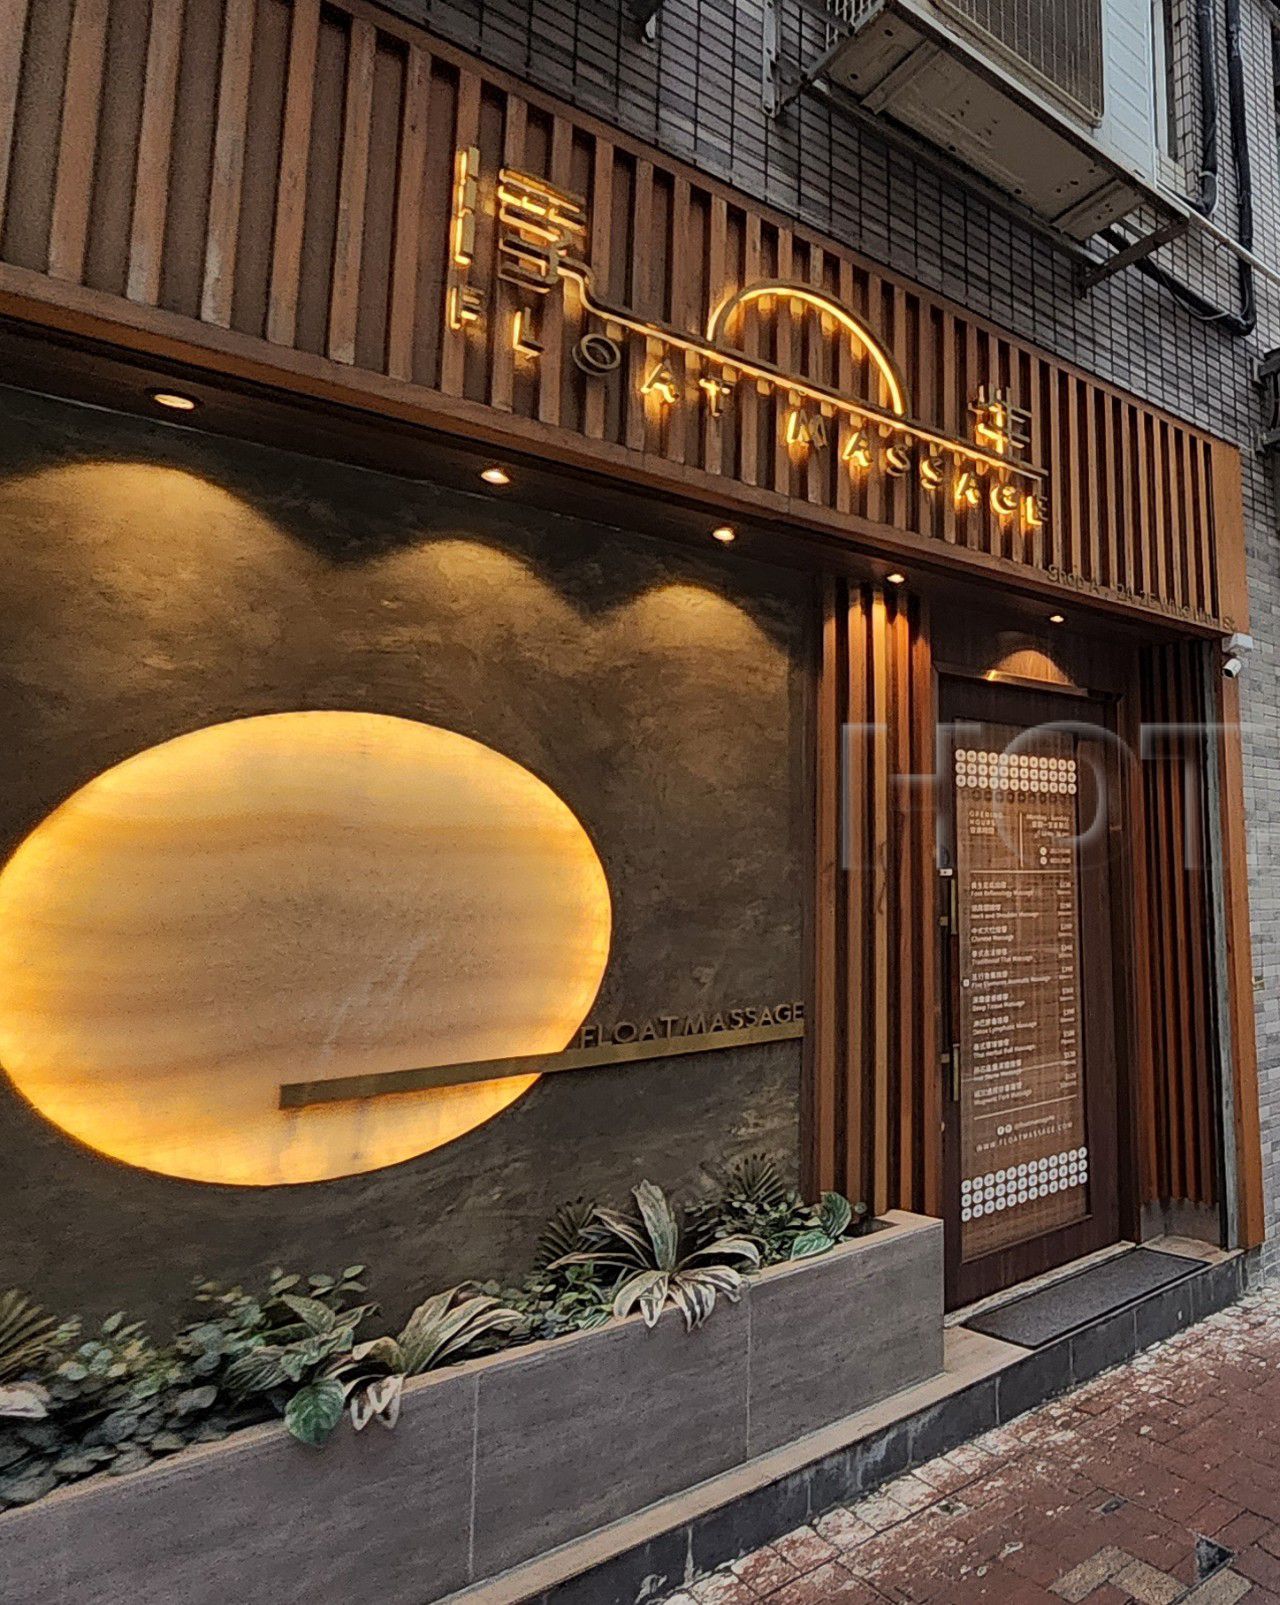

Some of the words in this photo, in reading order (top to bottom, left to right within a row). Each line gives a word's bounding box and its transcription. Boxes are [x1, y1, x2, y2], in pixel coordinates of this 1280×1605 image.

[449, 284, 733, 418] FLOAT
[785, 408, 1049, 527] MASSAGE
[580, 1014, 680, 1050] FLOAT
[683, 1001, 805, 1037] MASSAGE
